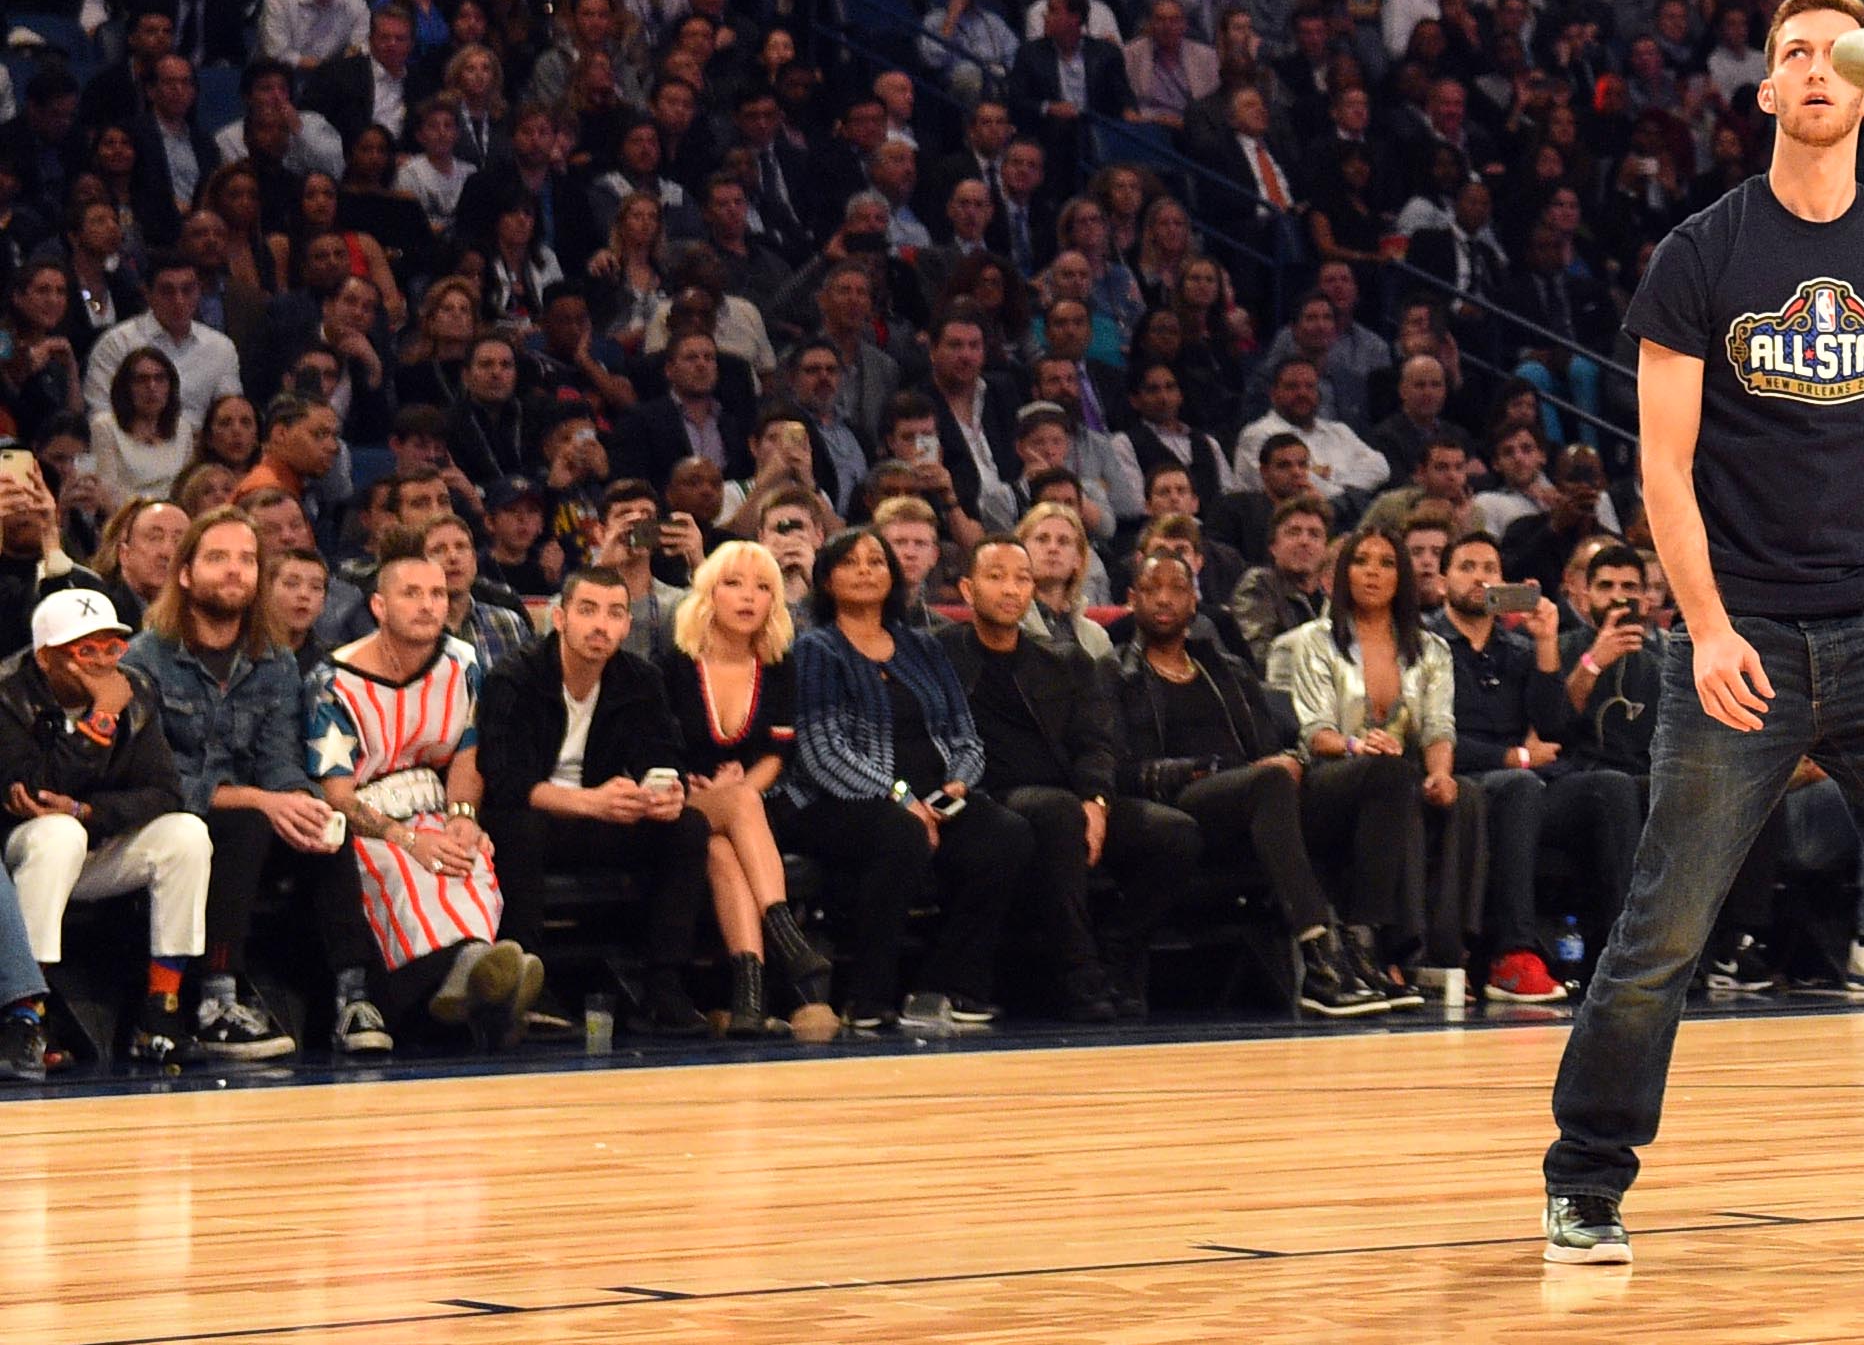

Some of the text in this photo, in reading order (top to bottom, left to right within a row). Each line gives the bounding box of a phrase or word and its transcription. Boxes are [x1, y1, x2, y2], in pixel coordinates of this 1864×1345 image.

[1750, 334, 1813, 377] ALL
[1765, 377, 1791, 390] NEW
[1797, 383, 1851, 397] ORLEANS
